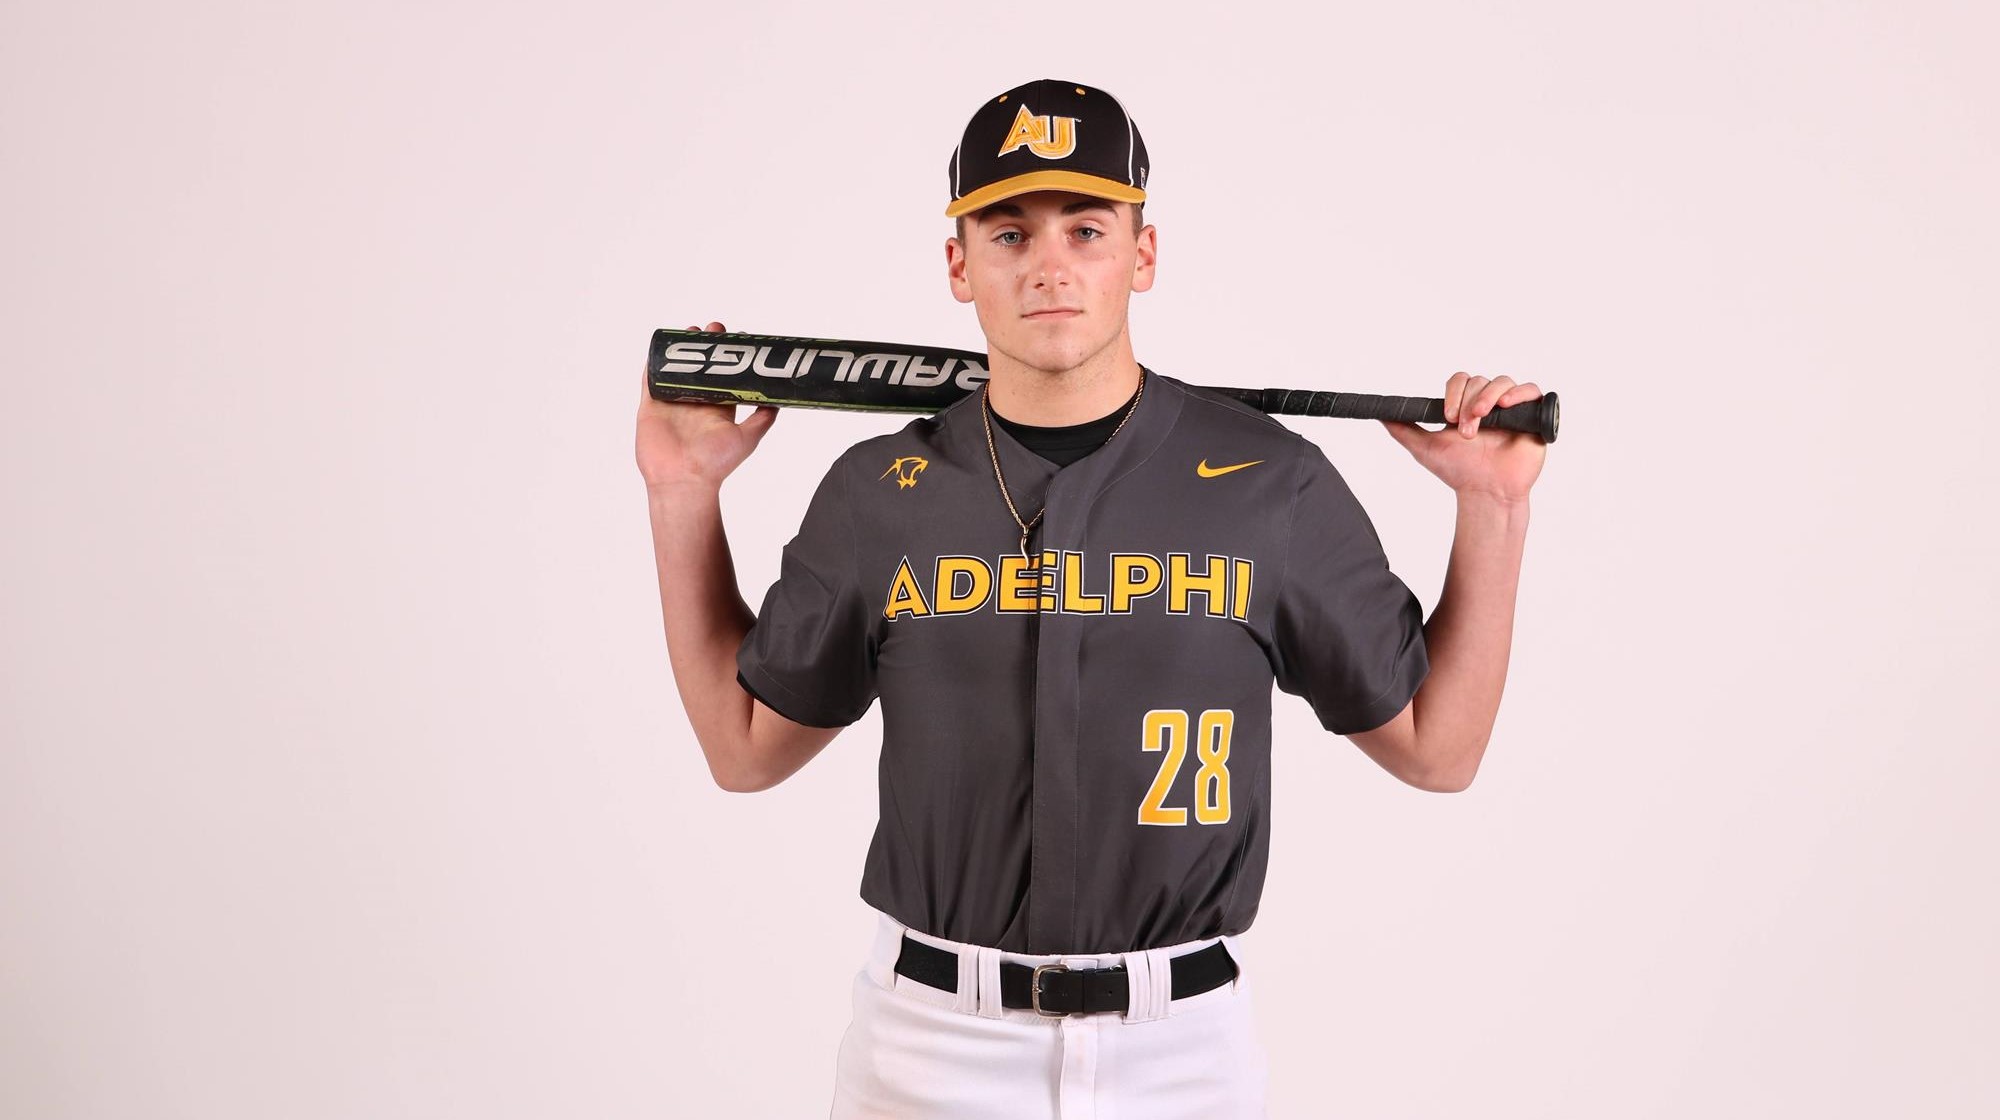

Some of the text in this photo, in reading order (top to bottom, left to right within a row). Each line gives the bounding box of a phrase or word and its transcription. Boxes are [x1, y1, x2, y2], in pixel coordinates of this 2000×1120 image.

[998, 104, 1076, 159] AU
[660, 342, 989, 391] RAWLINGS
[883, 550, 1253, 623] ADELPHI
[1138, 709, 1234, 826] 28
